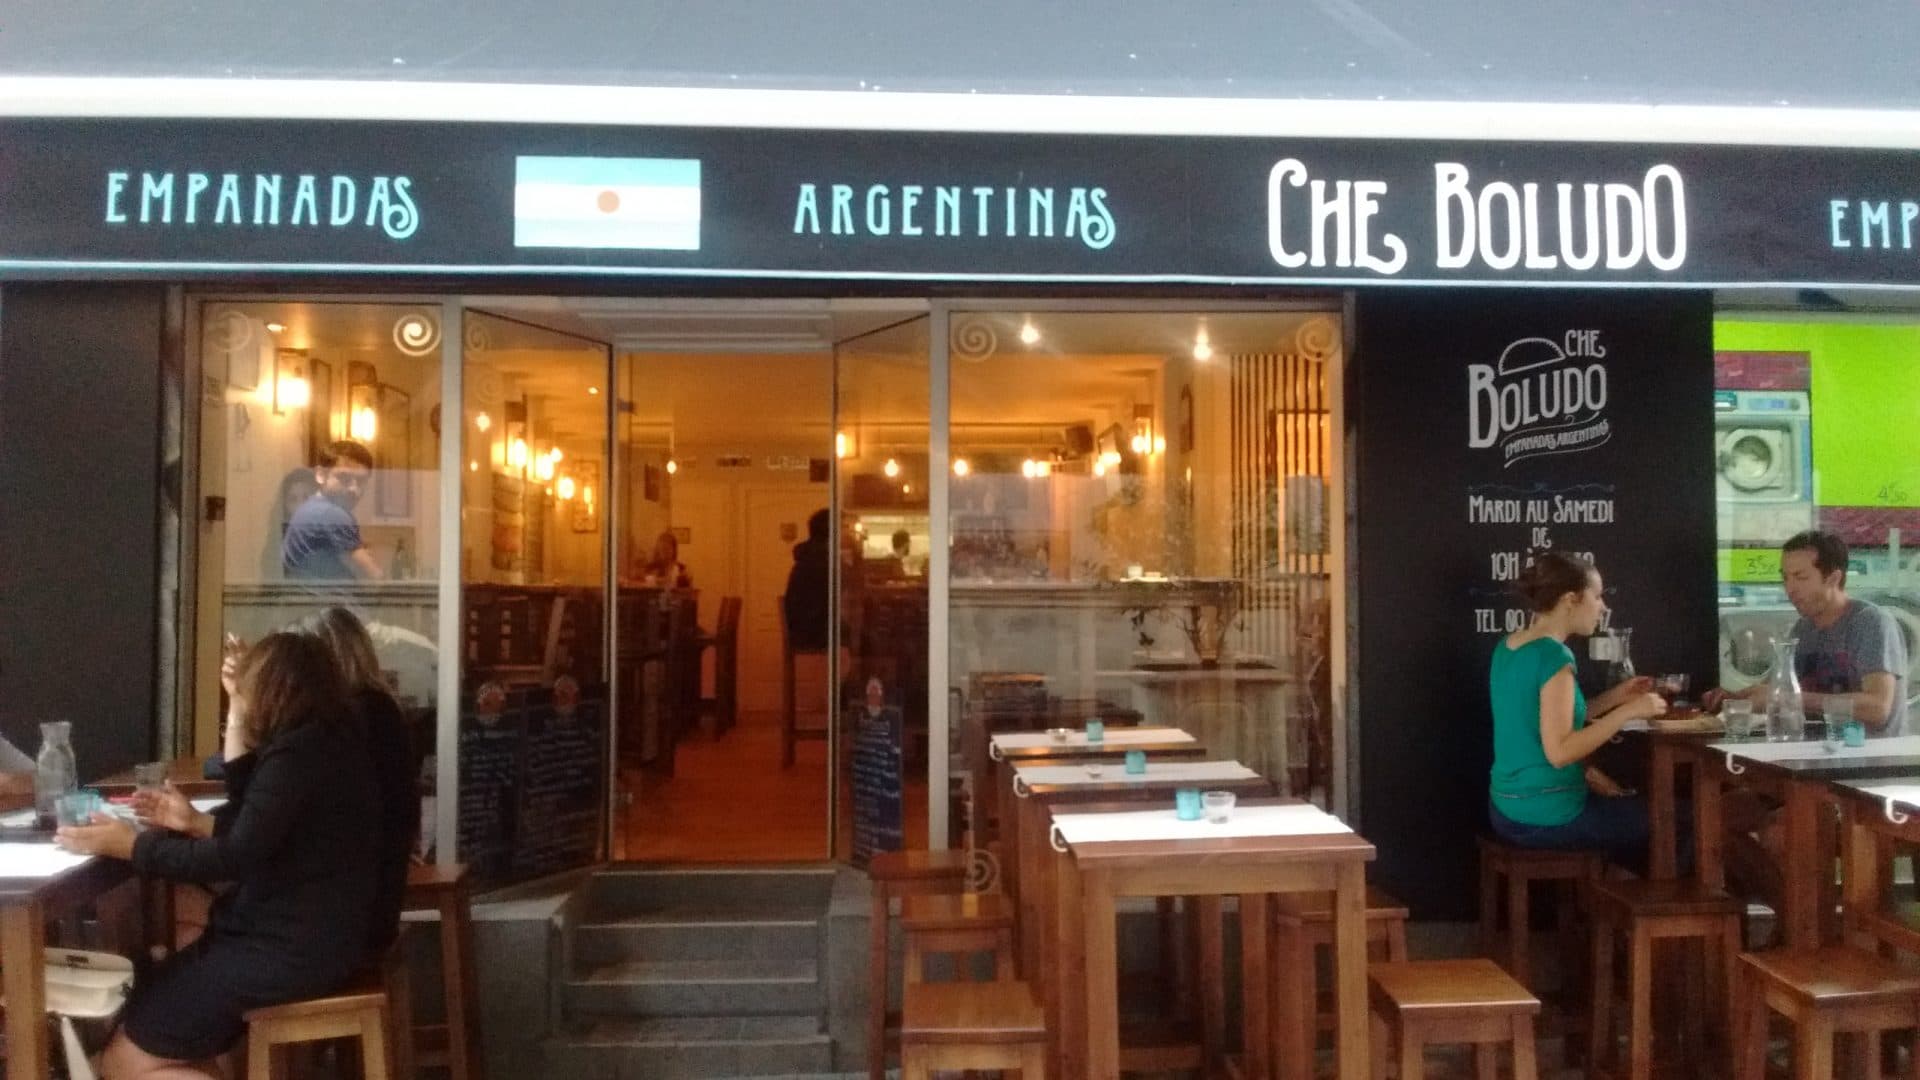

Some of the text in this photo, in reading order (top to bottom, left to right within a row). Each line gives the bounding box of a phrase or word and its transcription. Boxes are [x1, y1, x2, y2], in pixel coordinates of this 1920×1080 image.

[105, 172, 420, 239] EMPANADAS
[793, 183, 1117, 249] ARGENTINAS
[1267, 157, 1688, 275] CHE BOLUDO
[1565, 329, 1607, 359] CHE
[1468, 363, 1608, 449] BOLUDO
[1468, 494, 1615, 524] MARDI AU SAMEDI
[1531, 526, 1552, 549] DE
[1474, 608, 1503, 633] TEL.
